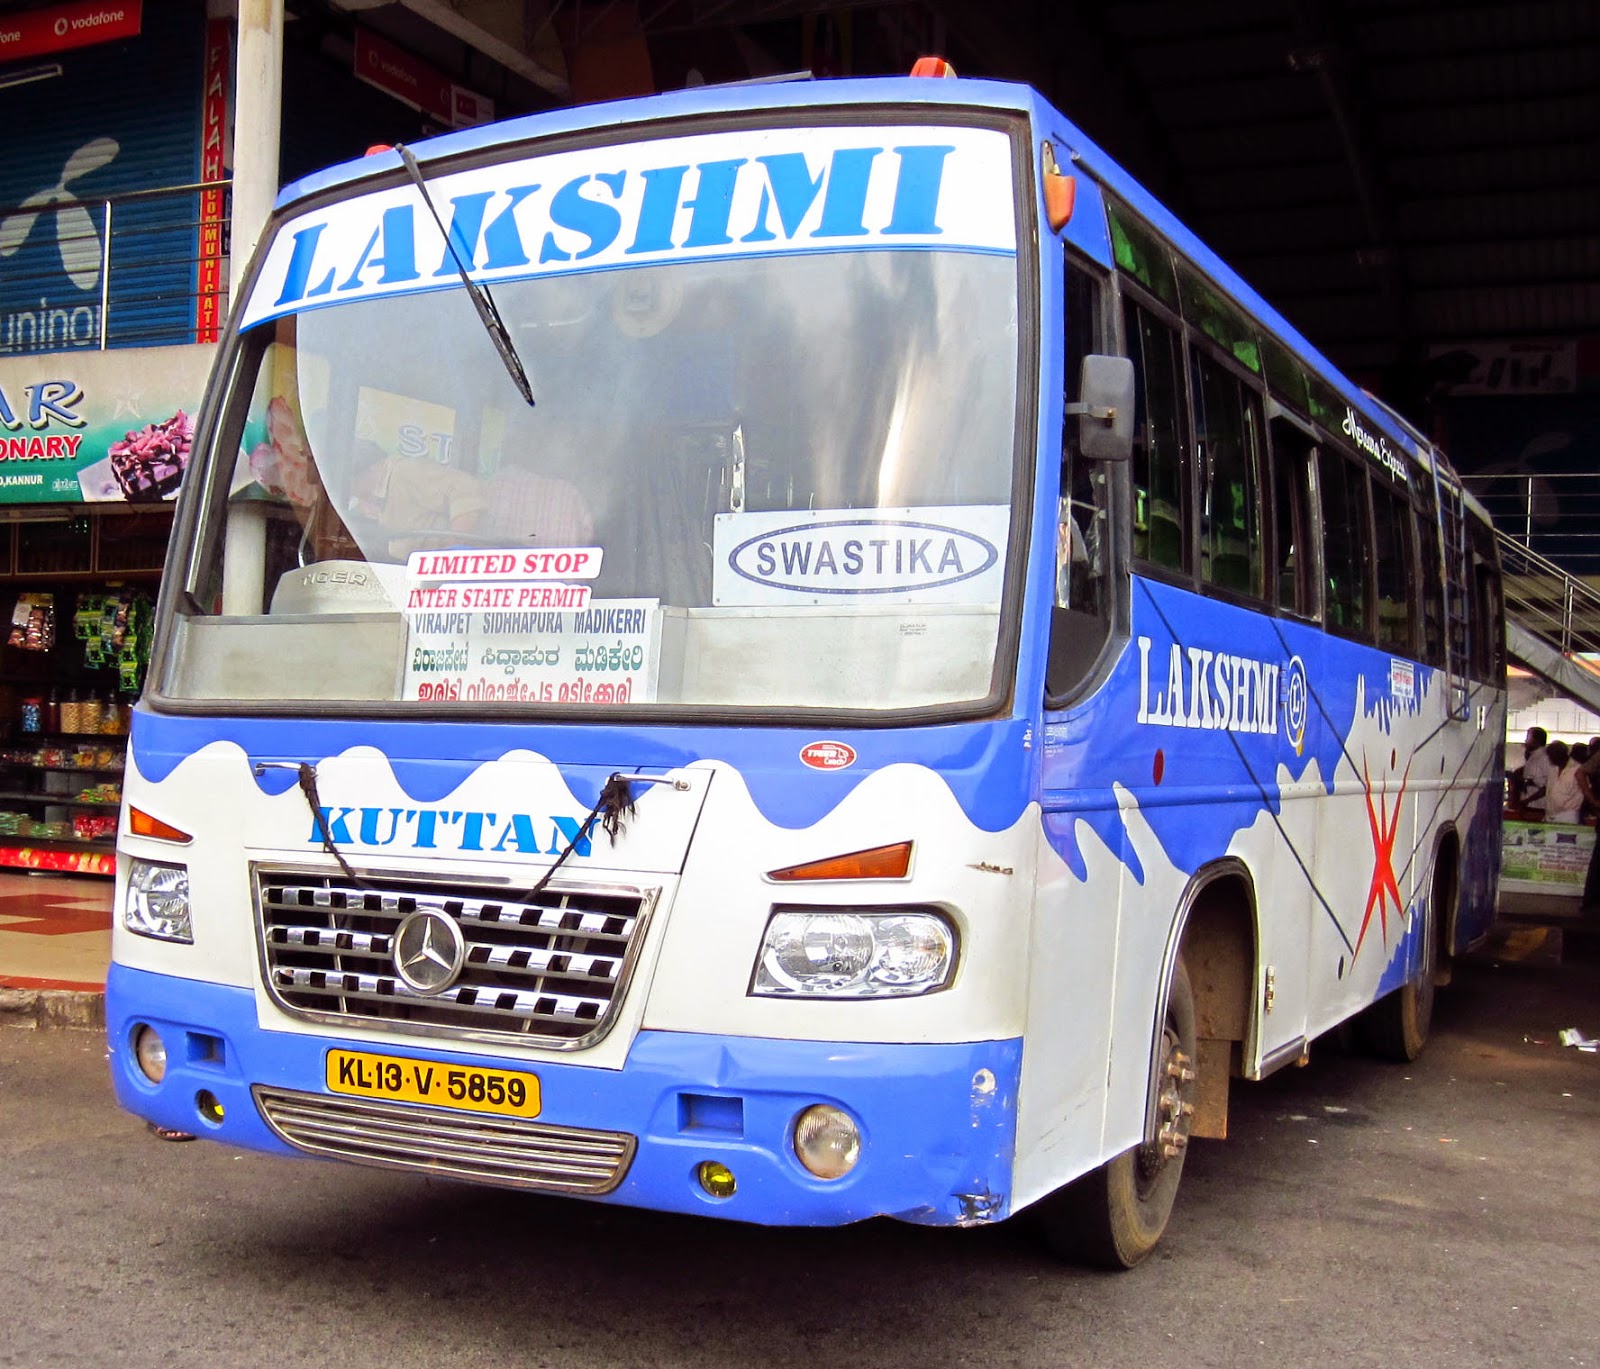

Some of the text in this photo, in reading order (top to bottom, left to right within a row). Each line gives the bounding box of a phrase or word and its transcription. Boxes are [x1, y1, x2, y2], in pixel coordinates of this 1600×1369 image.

[71, 9, 124, 30] vodafone
[208, 47, 223, 181] FALAH
[273, 144, 956, 307] LAKSHMI
[203, 188, 217, 344] COMMUNICATI
[417, 552, 589, 576] LIMITED STOP
[757, 538, 964, 576] SWASTIKA
[407, 587, 588, 608] INTER STATE PERMIT
[415, 608, 646, 635] VIRAJPET SIDHHAPURA MADIKERRI
[1137, 636, 1279, 734] LAKSHMI
[307, 806, 601, 857] KUTTAN
